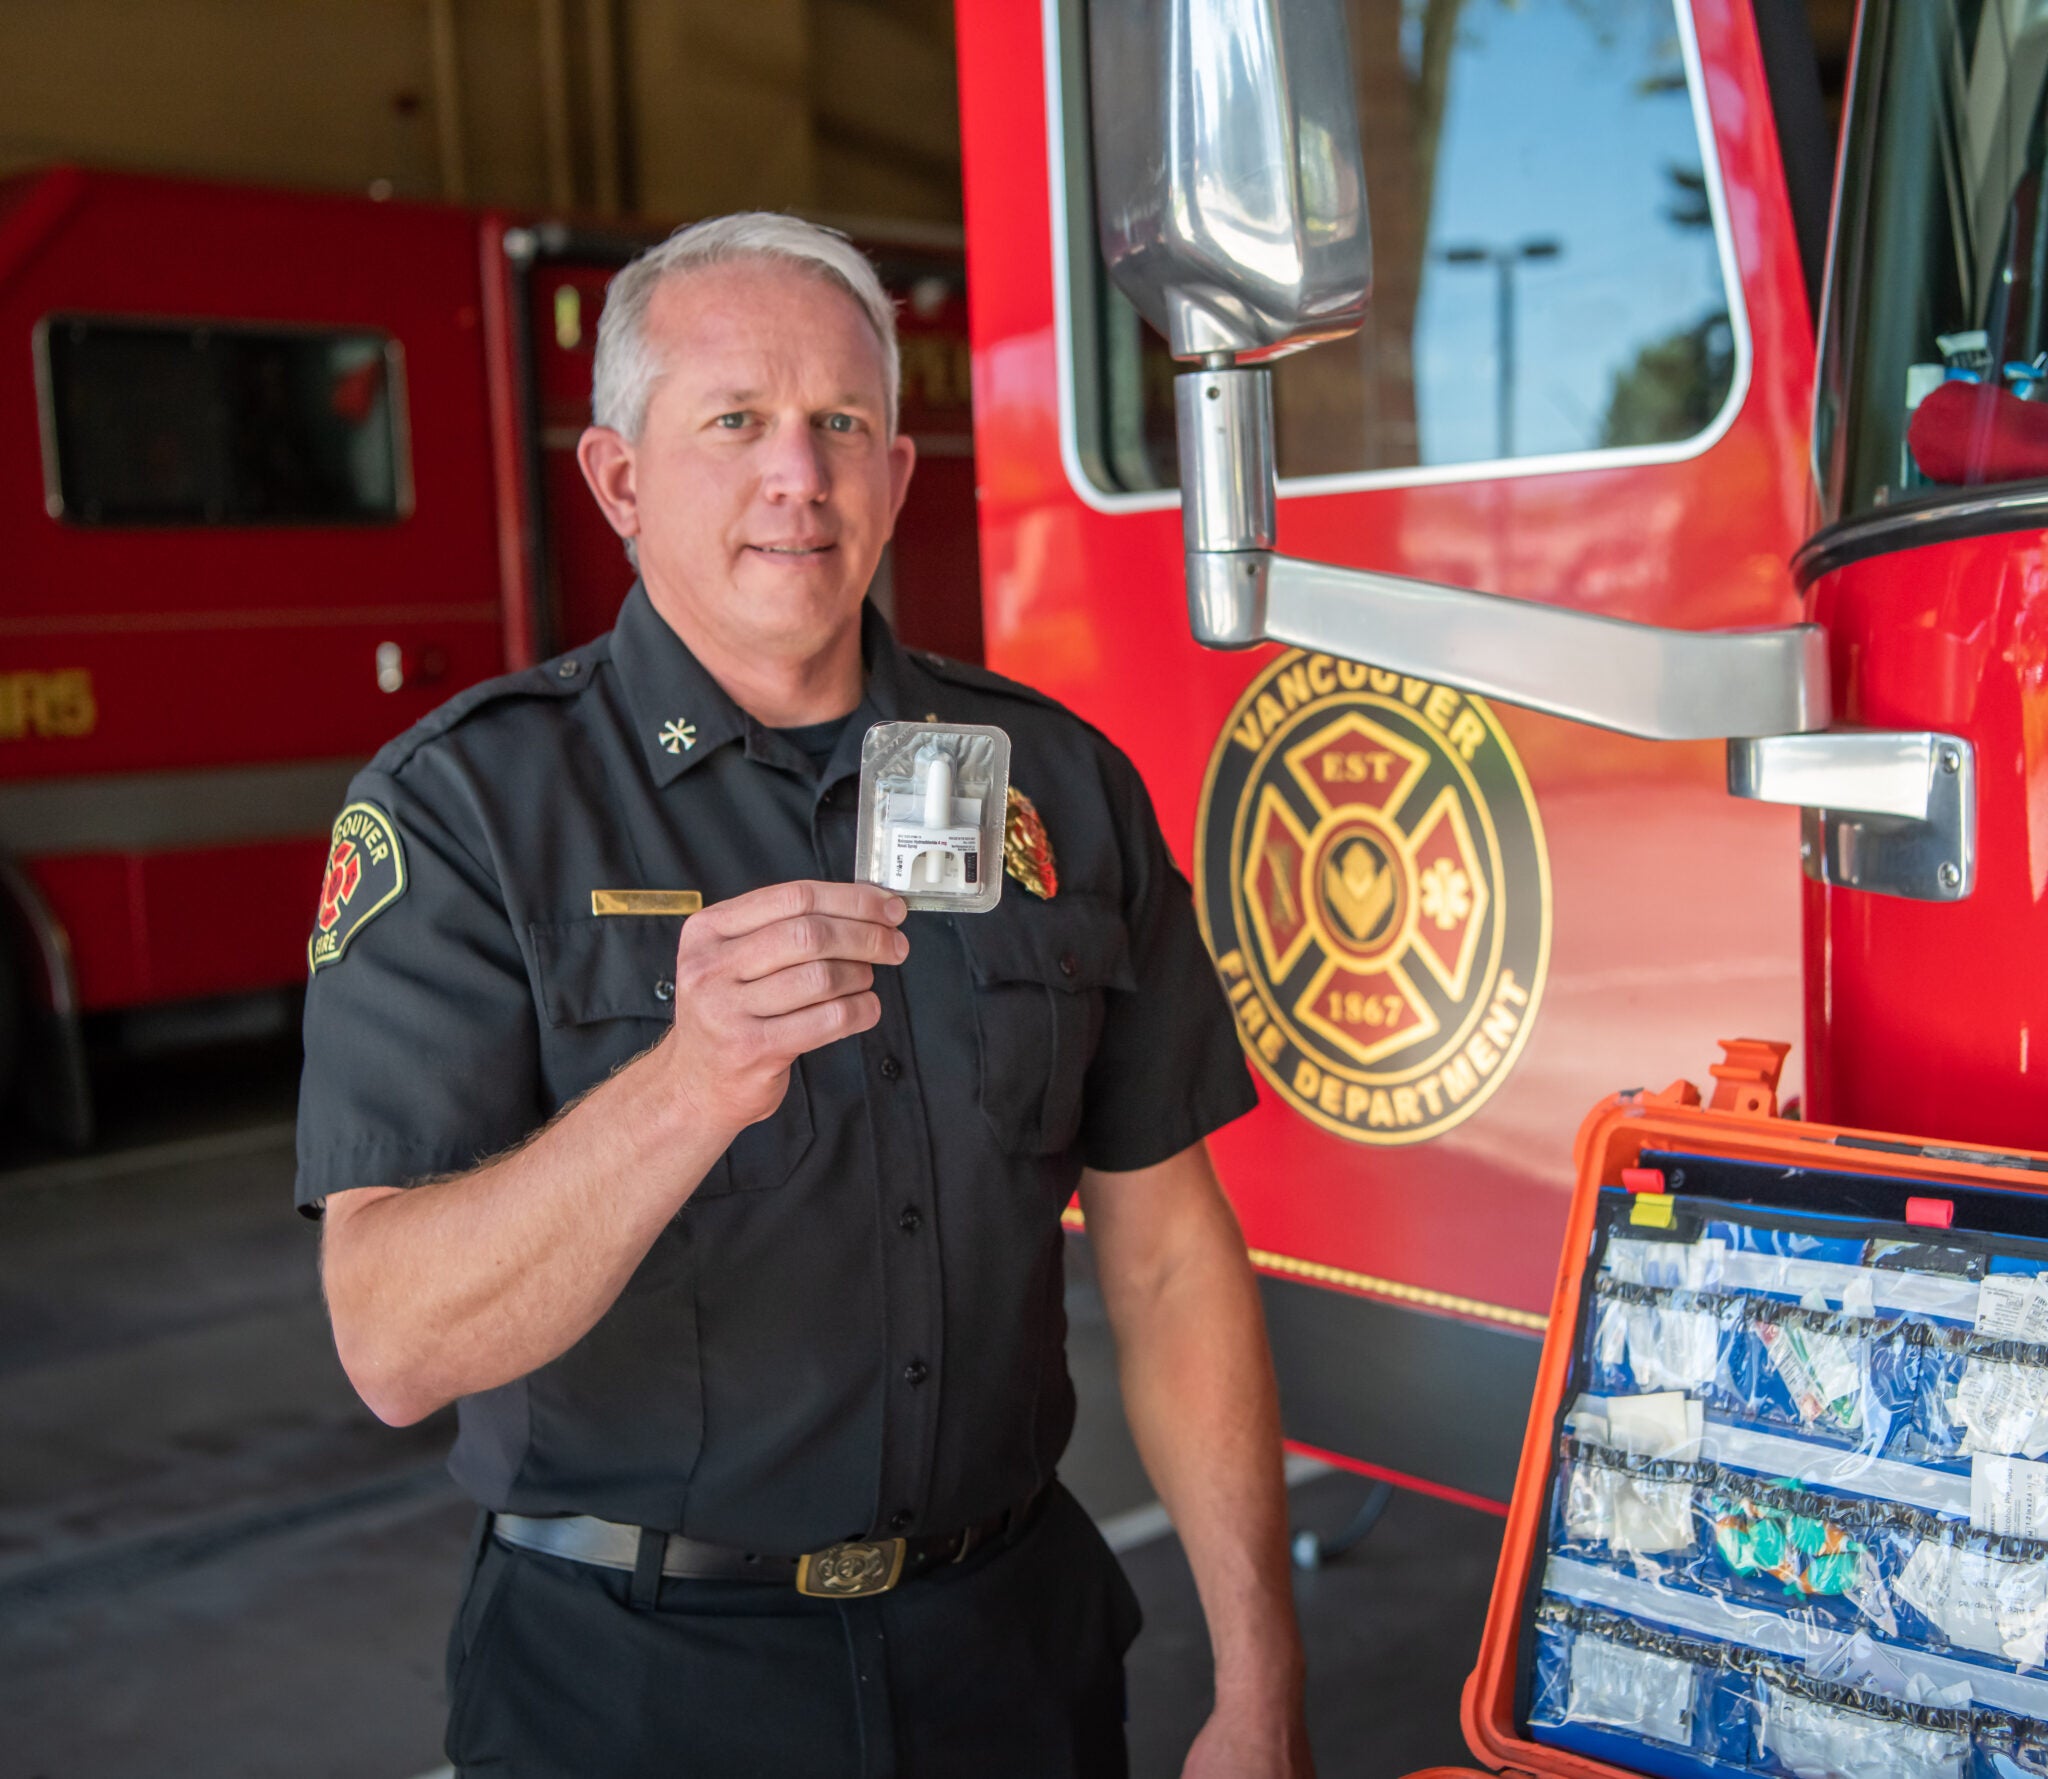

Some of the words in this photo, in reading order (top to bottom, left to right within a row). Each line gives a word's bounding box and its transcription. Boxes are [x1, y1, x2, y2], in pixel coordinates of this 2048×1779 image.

[1232, 652, 1487, 762] VANCOUVER
[1322, 752, 1396, 783] EST
[333, 813, 389, 866] COUVER
[1218, 949, 1287, 1064] FIRE
[1328, 991, 1404, 1028] 1867
[1294, 968, 1529, 1128] DEPARTMENT
